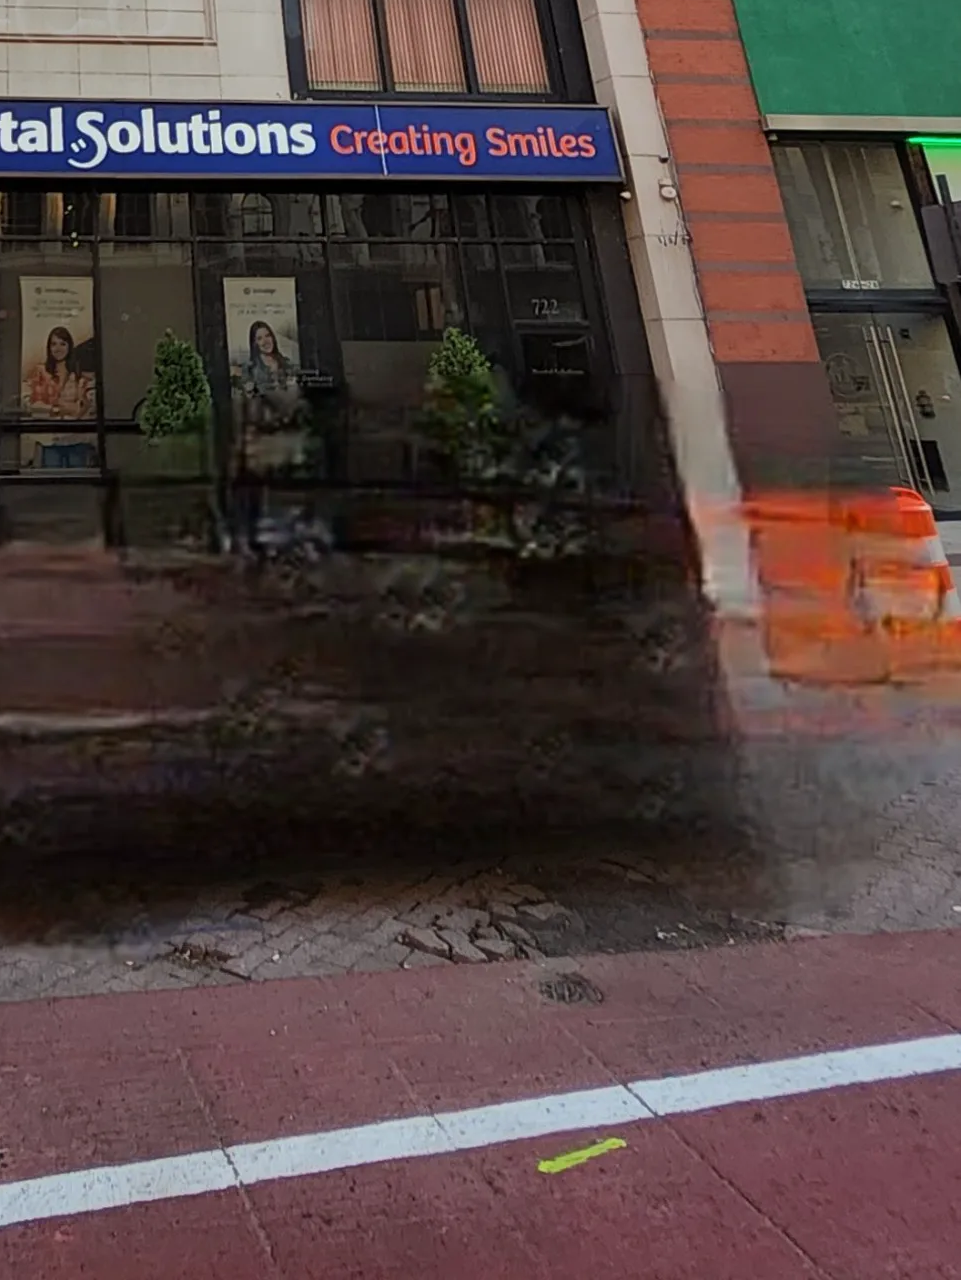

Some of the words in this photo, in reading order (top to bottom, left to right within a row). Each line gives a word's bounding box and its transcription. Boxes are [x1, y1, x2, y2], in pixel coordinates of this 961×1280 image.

[68, 107, 316, 169] Solutions
[330, 123, 477, 166] Creating
[486, 126, 596, 158] Smiles
[530, 297, 561, 316] 722
